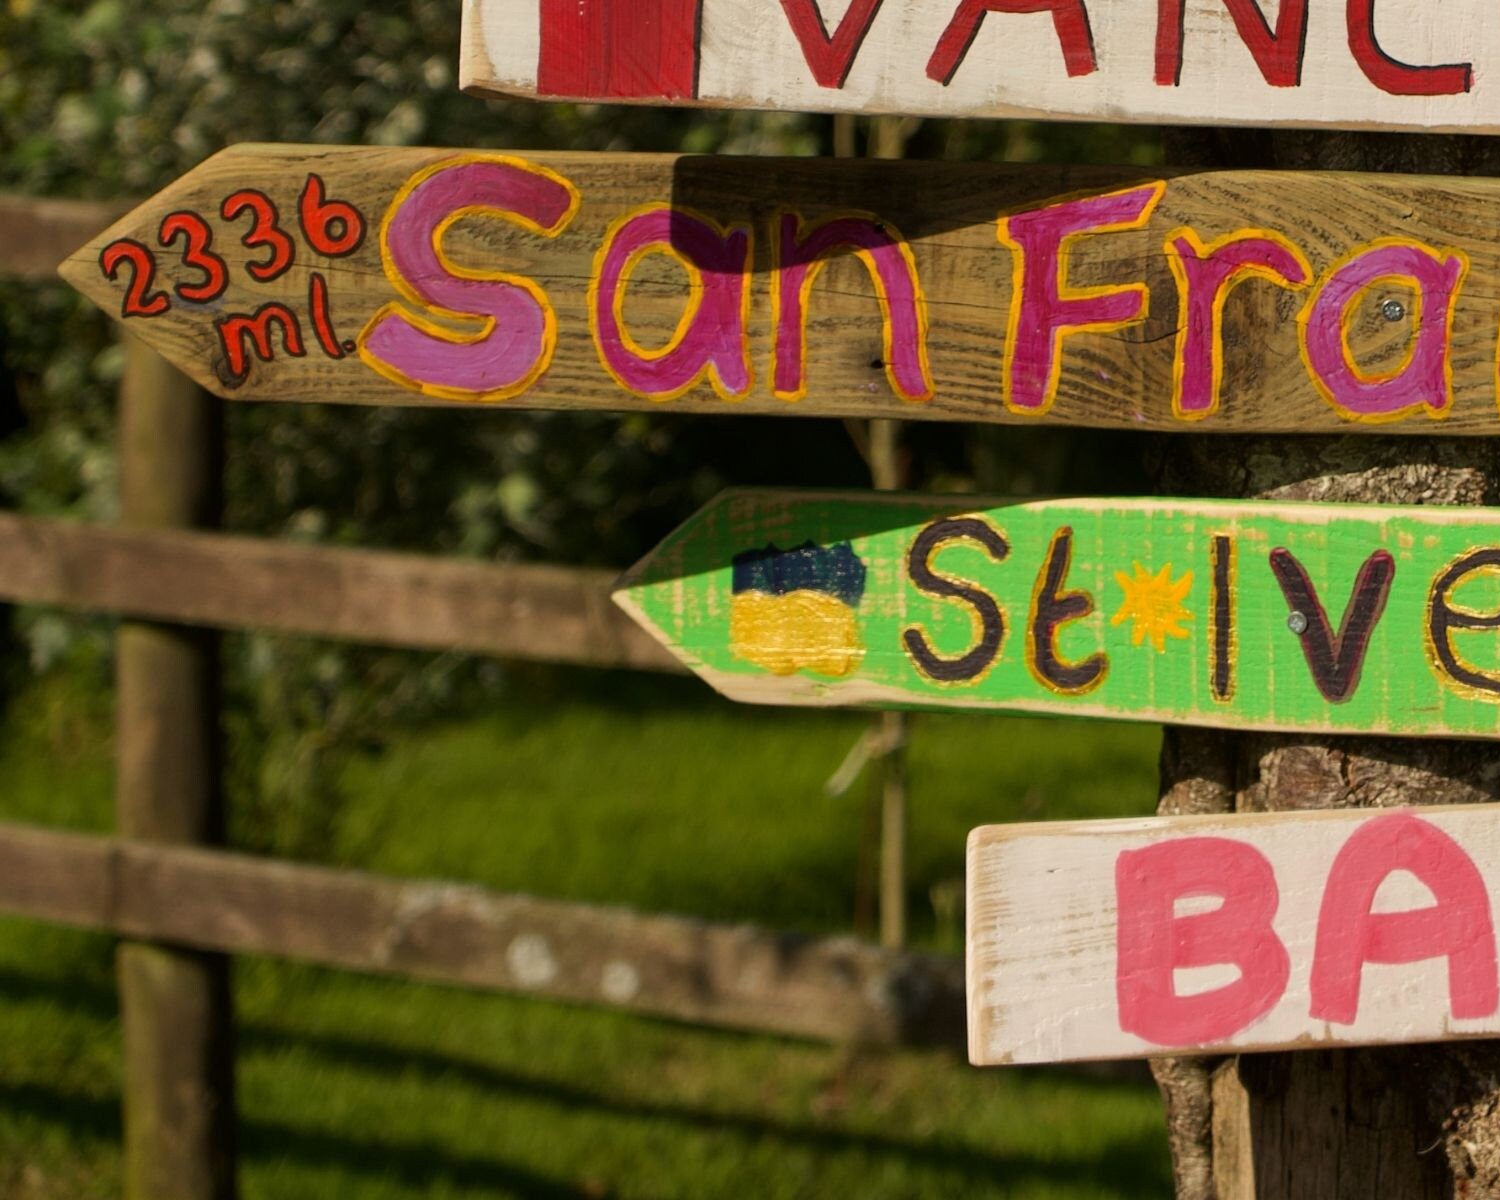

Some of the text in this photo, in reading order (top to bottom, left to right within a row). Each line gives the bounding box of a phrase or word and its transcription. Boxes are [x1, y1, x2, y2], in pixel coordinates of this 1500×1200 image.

[100, 171, 366, 318] 2336
[357, 153, 935, 402] San
[902, 512, 1109, 696] St
